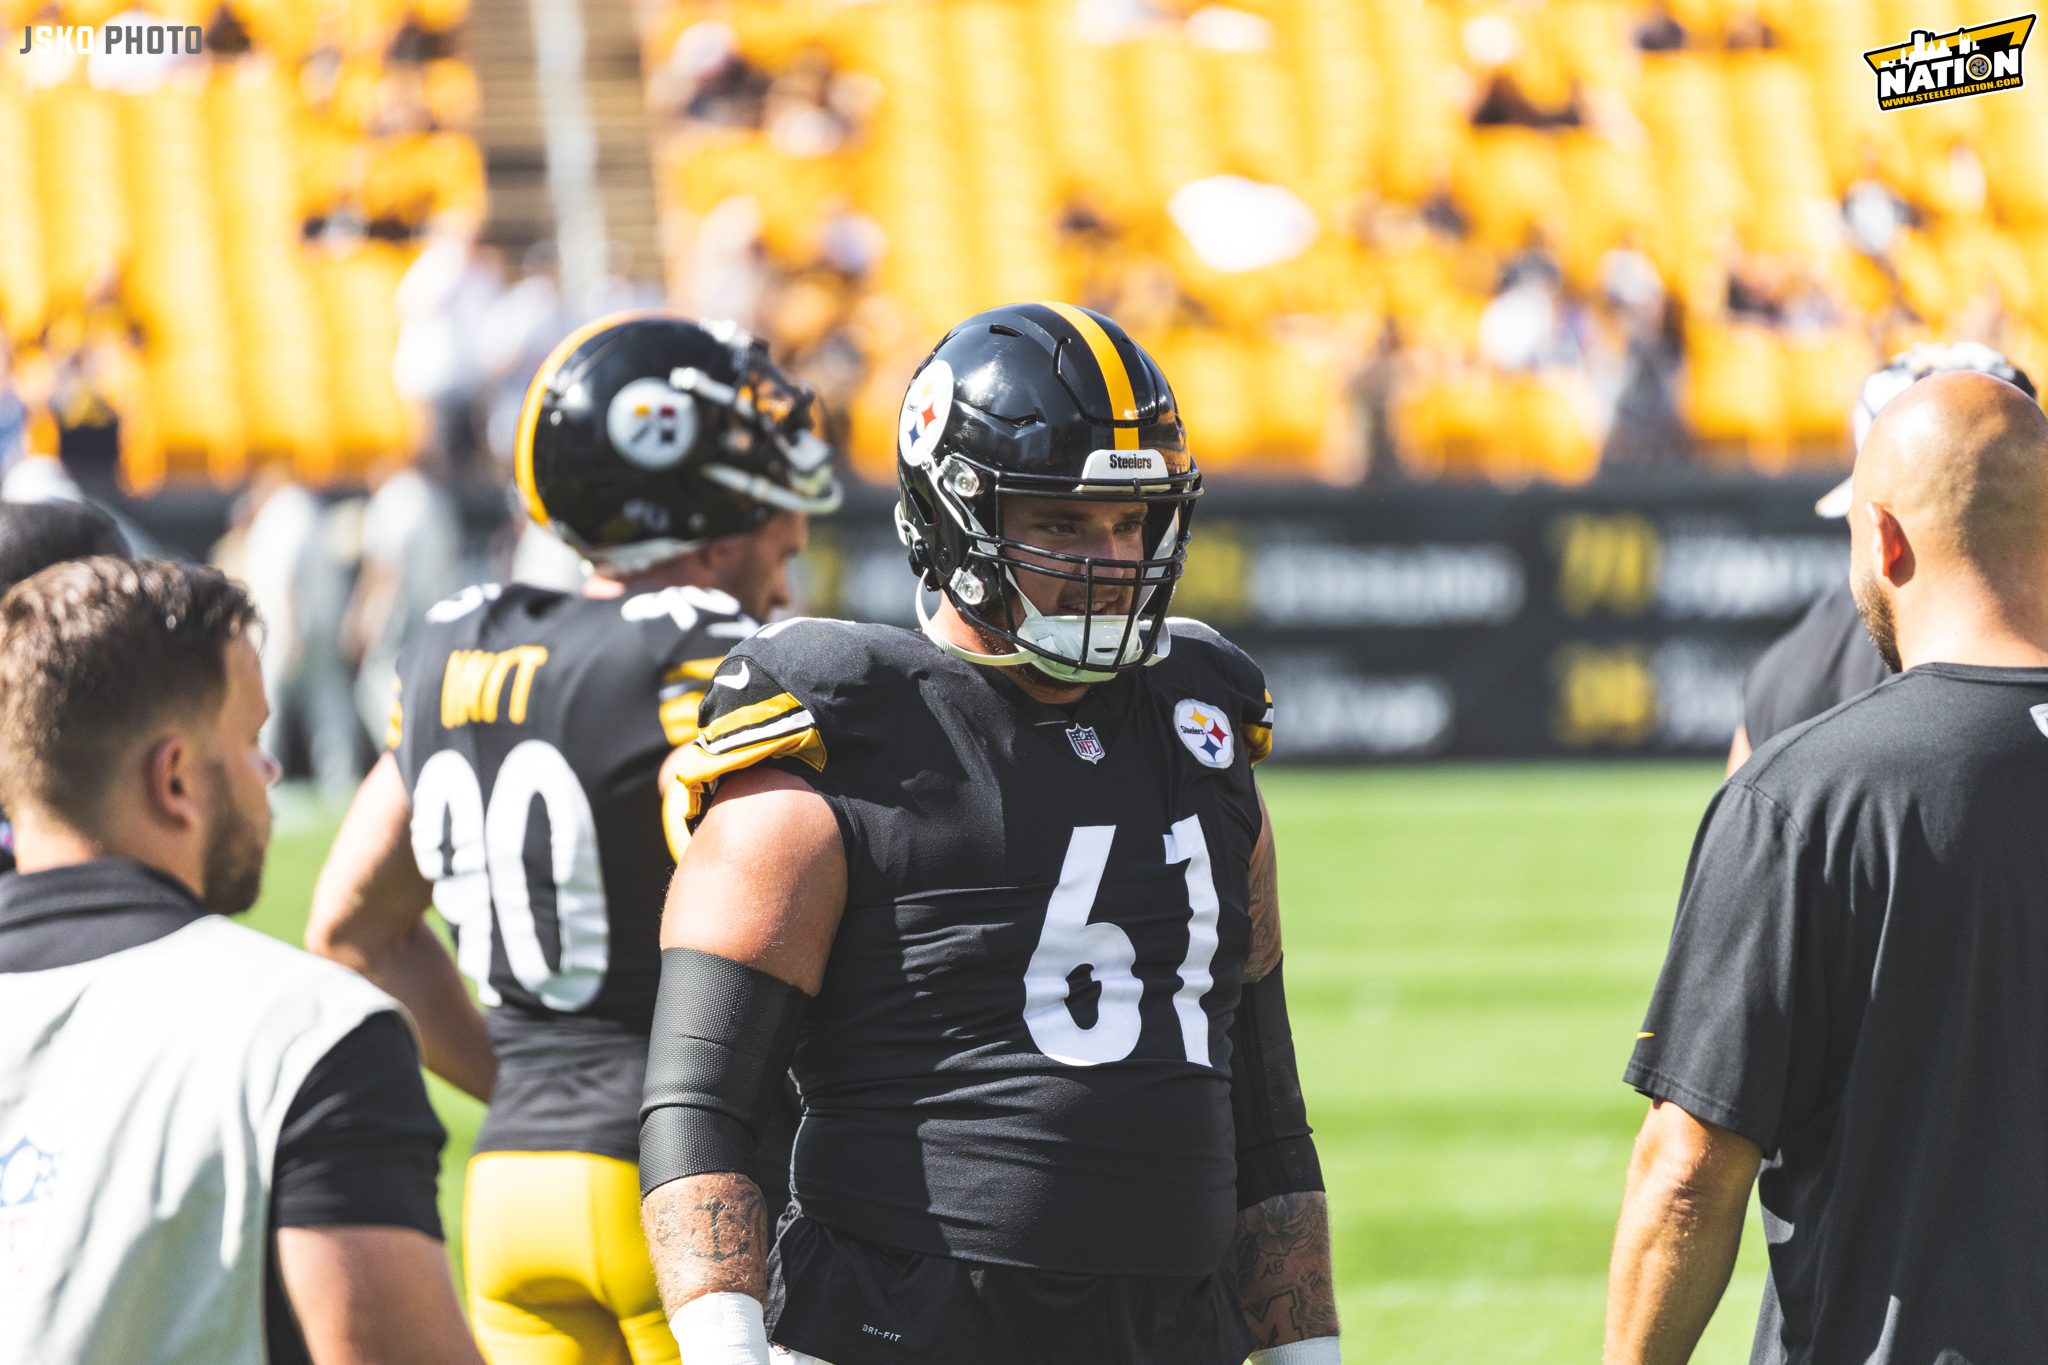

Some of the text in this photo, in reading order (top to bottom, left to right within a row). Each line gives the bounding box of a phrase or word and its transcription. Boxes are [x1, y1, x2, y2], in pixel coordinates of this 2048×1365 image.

[1109, 453, 1152, 469] Steelers
[1076, 740, 1101, 756] NFL
[410, 739, 609, 1012] 90
[1023, 813, 1219, 1067] 61
[862, 1324, 902, 1342] DRI-FIT
